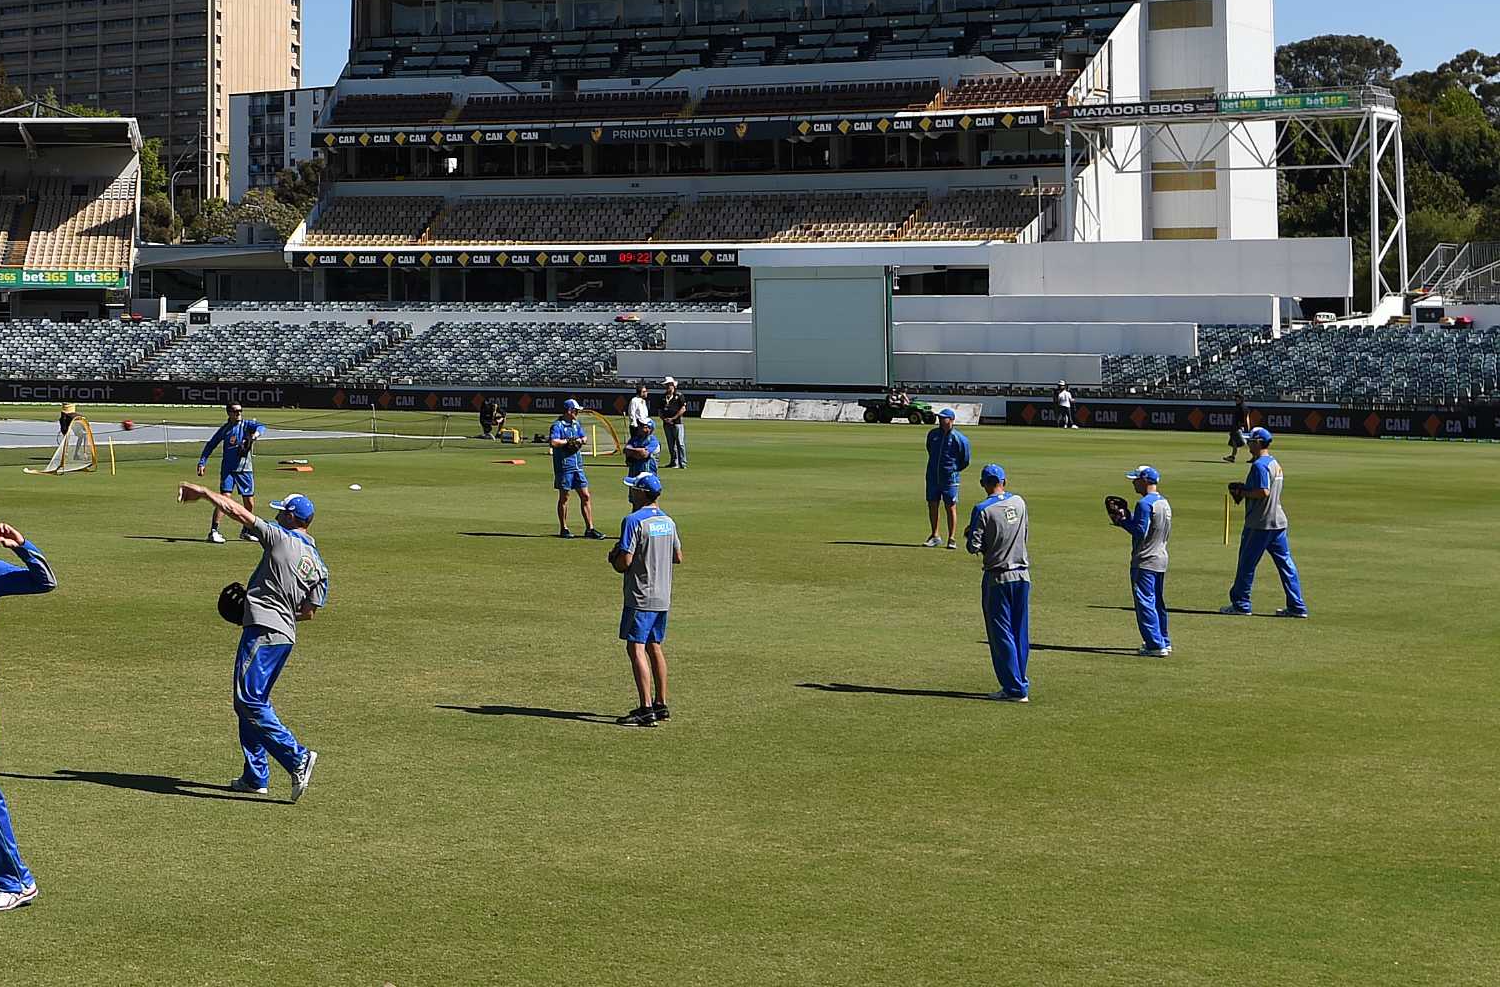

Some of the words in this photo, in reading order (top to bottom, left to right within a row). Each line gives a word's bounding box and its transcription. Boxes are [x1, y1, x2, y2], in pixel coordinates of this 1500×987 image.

[1073, 104, 1145, 117] MATADOR
[1149, 103, 1194, 114] BBQS
[893, 120, 912, 129] CAN
[935, 119, 954, 128] CAN
[975, 117, 995, 126] CAN
[1018, 115, 1037, 124] CAN
[813, 123, 831, 132] CAN
[854, 122, 872, 131] CAN
[446, 133, 463, 142] CAN
[486, 132, 503, 141] CAN
[521, 132, 538, 140] CAN
[612, 128, 684, 139] PRINDIVILLE
[687, 127, 725, 137] STAND
[374, 135, 390, 143] CAN
[409, 134, 426, 143] CAN
[473, 255, 490, 263] CAN
[512, 255, 529, 263] CAN
[551, 255, 569, 263] CAN
[589, 254, 606, 263] CAN
[619, 252, 650, 263] 09:22
[671, 254, 689, 262] CAN
[716, 253, 735, 262] CAN
[23, 271, 67, 282] bet365
[75, 272, 120, 283] bet365
[8, 383, 114, 400] Techfront
[177, 385, 284, 403] Techfront
[350, 394, 369, 405] CAN
[396, 395, 415, 407] CAN
[443, 396, 462, 408] CAN
[536, 398, 555, 409] CAN
[1095, 410, 1118, 422] CAN
[1151, 412, 1175, 424] CAN
[1209, 413, 1233, 425] CAN
[1268, 415, 1291, 427] CAN
[1326, 416, 1349, 429] CAN
[1386, 418, 1410, 431] CAN
